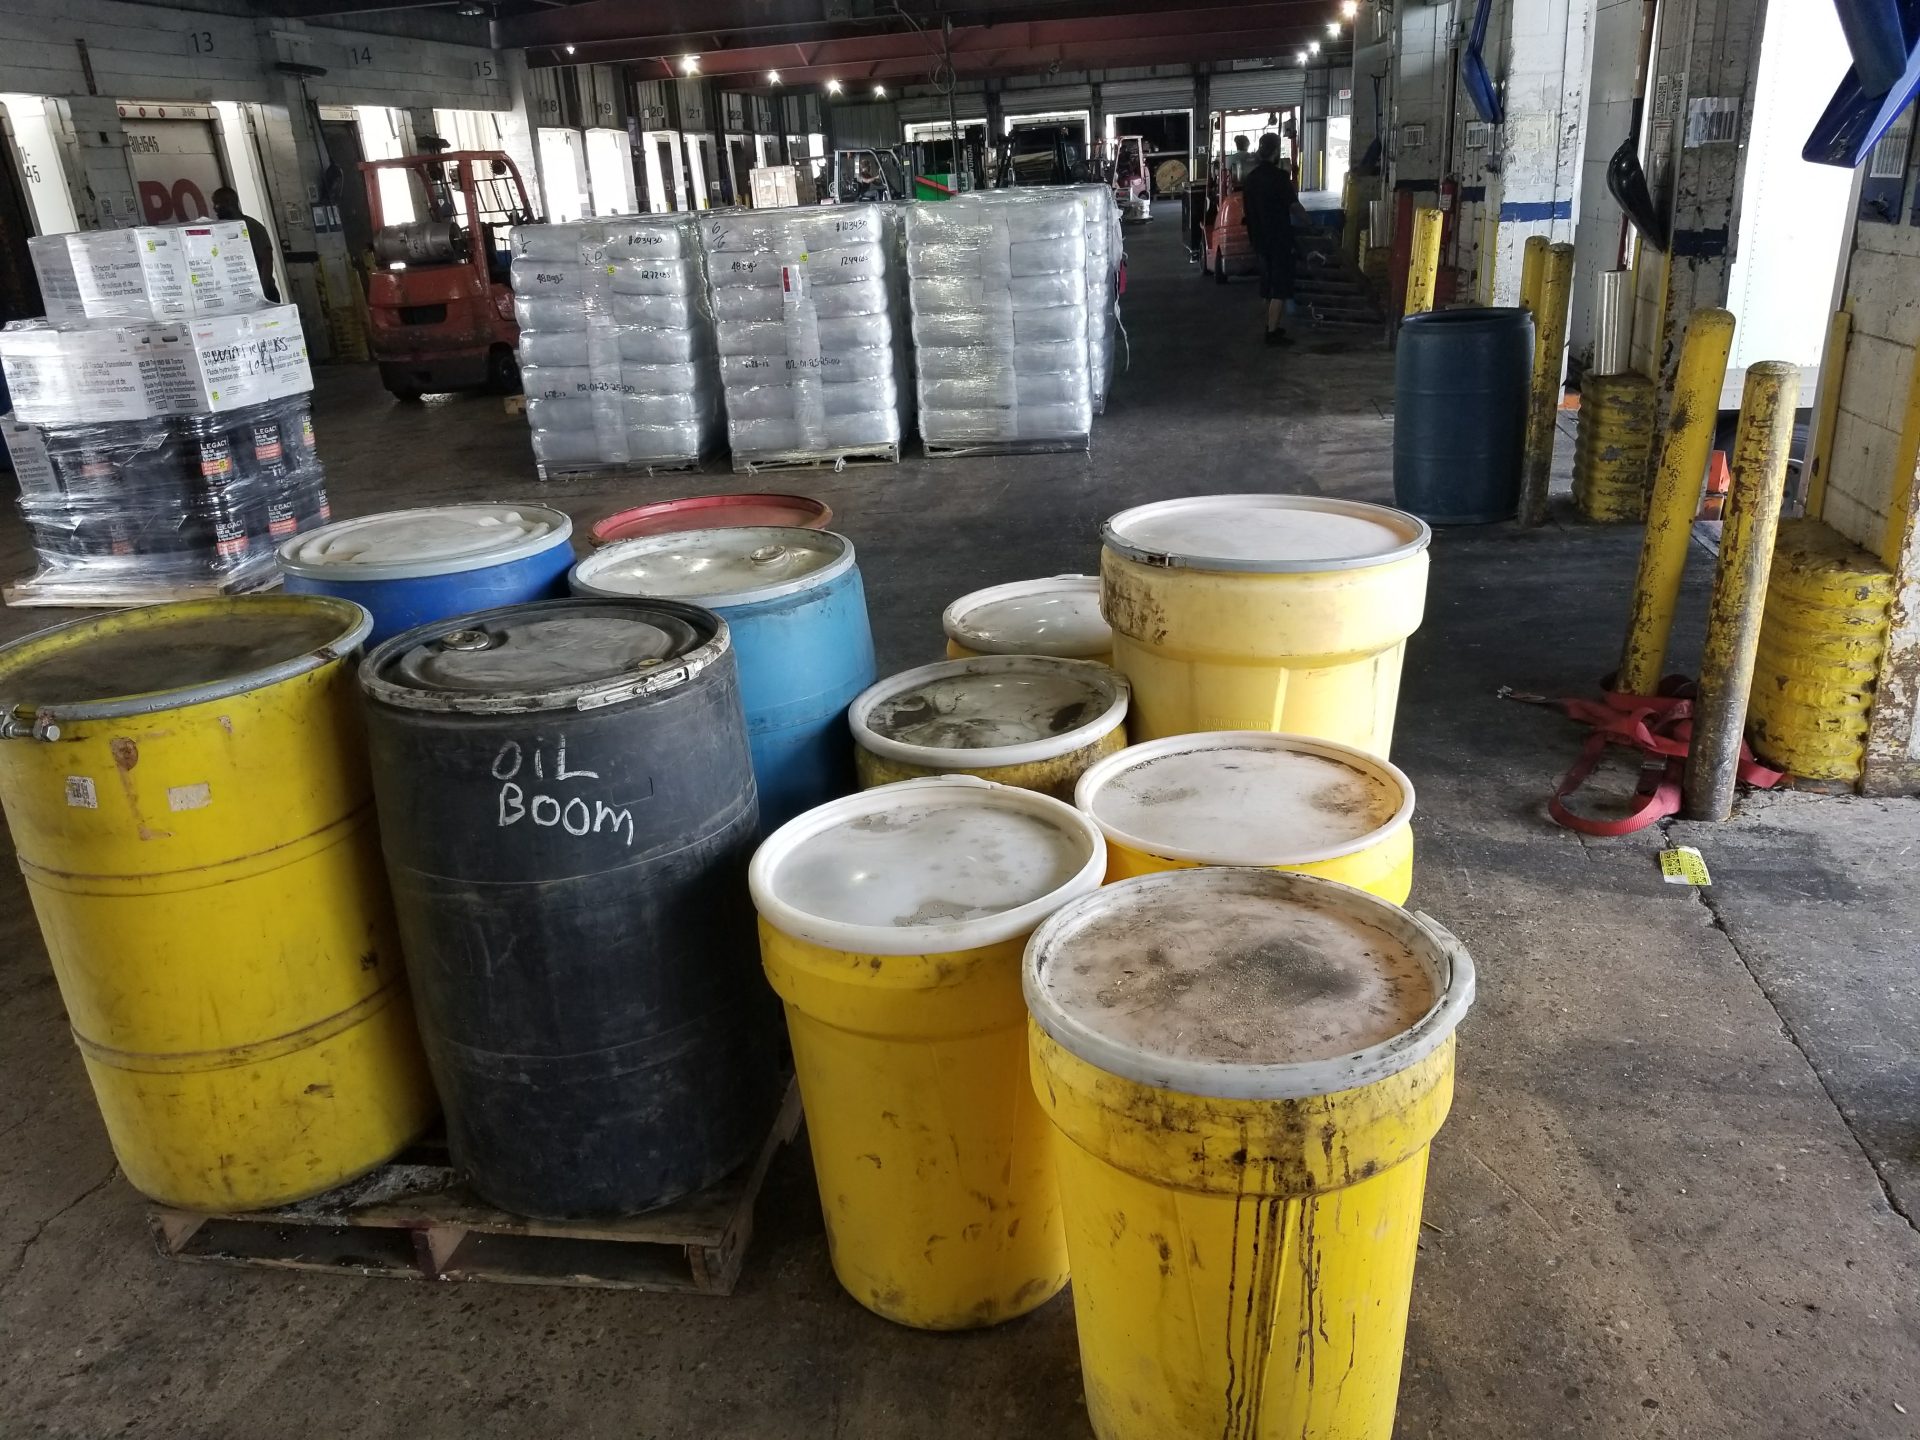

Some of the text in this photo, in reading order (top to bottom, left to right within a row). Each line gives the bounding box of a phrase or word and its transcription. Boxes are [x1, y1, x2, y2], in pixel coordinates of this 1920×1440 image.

[190, 31, 214, 53] 13
[351, 47, 373, 65] 14
[474, 60, 493, 77] 15
[543, 100, 558, 113] 18
[599, 102, 612, 114] 19
[651, 106, 664, 117] 20
[688, 108, 701, 119] 21
[730, 110, 742, 120] 22
[129, 135, 160, 154] 311-1545
